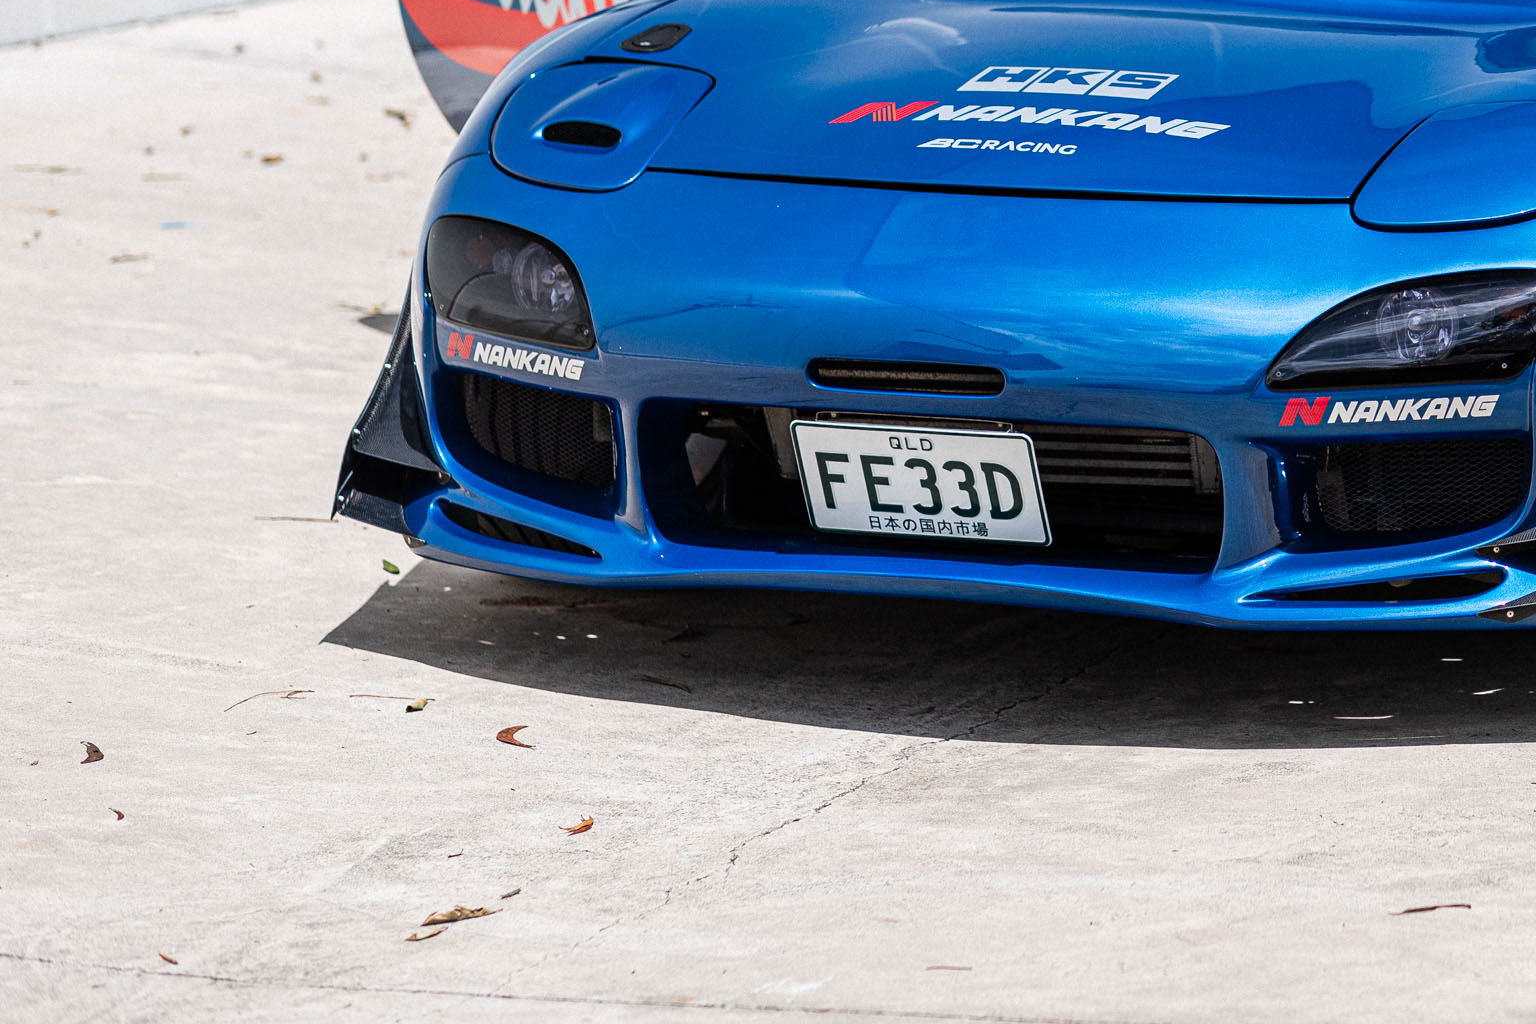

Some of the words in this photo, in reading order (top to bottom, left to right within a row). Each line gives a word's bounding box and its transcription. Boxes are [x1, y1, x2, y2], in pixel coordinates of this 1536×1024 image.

[957, 65, 1181, 101] HKS
[911, 104, 1232, 140] NANKANG
[473, 342, 585, 381] NANKANG
[1327, 394, 1501, 425] NANKANG
[888, 436, 934, 452] QLD
[814, 451, 1024, 521] FE33D
[868, 514, 990, 538] 日本の国内市場
